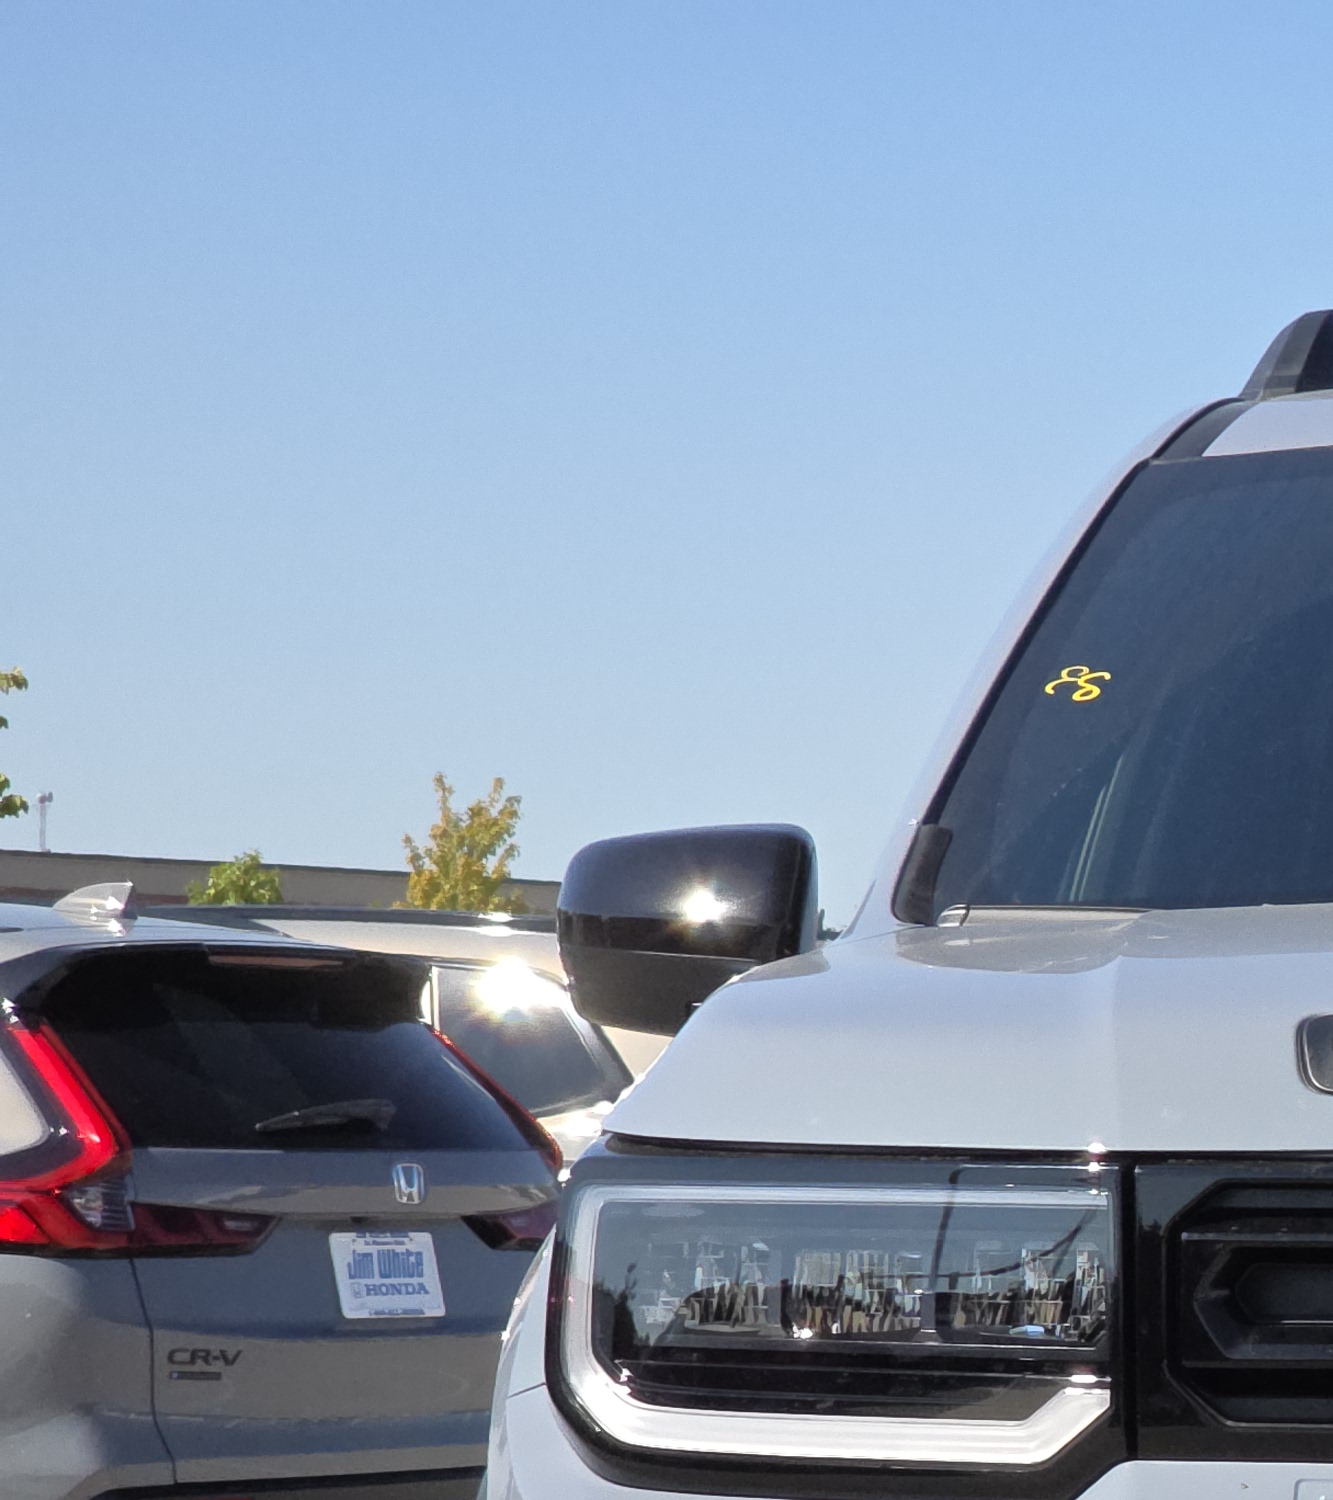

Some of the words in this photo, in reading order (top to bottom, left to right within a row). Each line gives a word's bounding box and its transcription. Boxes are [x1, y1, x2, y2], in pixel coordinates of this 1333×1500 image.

[346, 1248, 375, 1280] Jim
[377, 1248, 424, 1280] White
[364, 1282, 430, 1297] HONDA
[167, 1347, 243, 1367] CR-V
